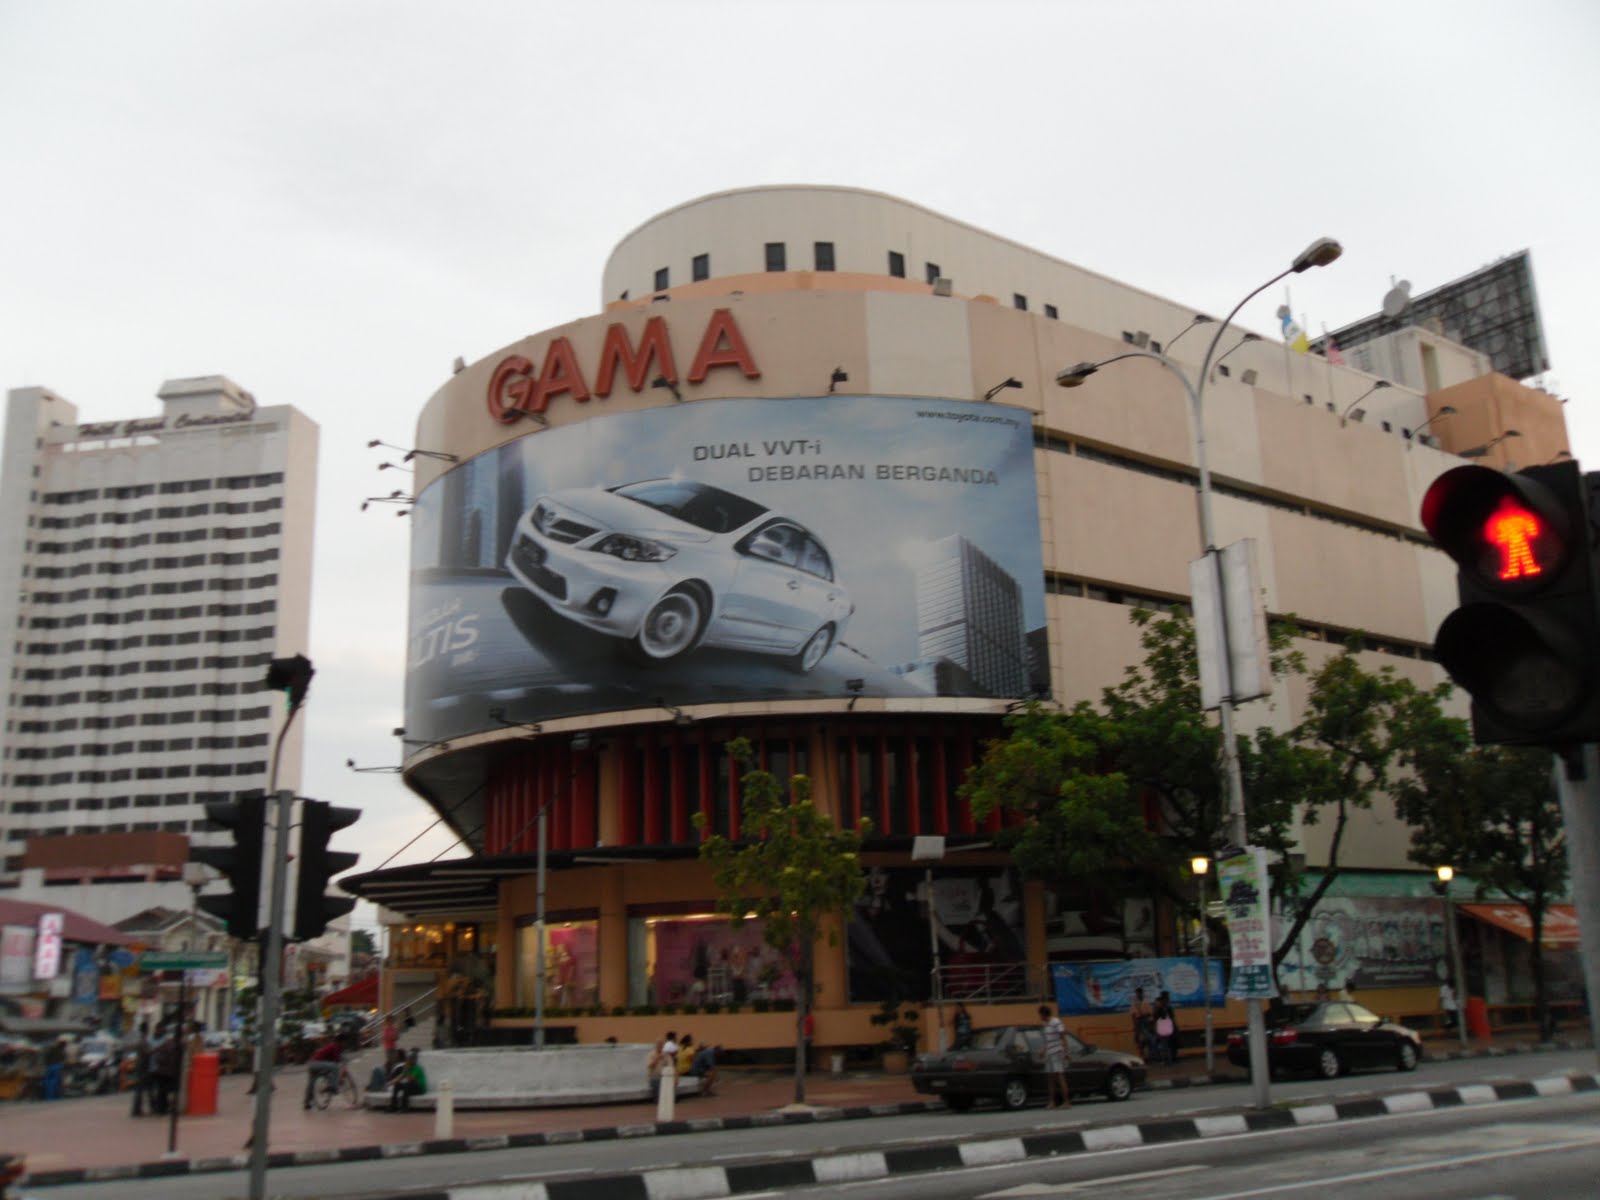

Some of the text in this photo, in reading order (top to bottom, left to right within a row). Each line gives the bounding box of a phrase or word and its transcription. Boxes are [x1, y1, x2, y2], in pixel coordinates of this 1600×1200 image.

[487, 308, 762, 425] GAMA
[692, 439, 822, 462] DUAL VVT-i
[748, 464, 999, 486] DEBARAN BERGANDA
